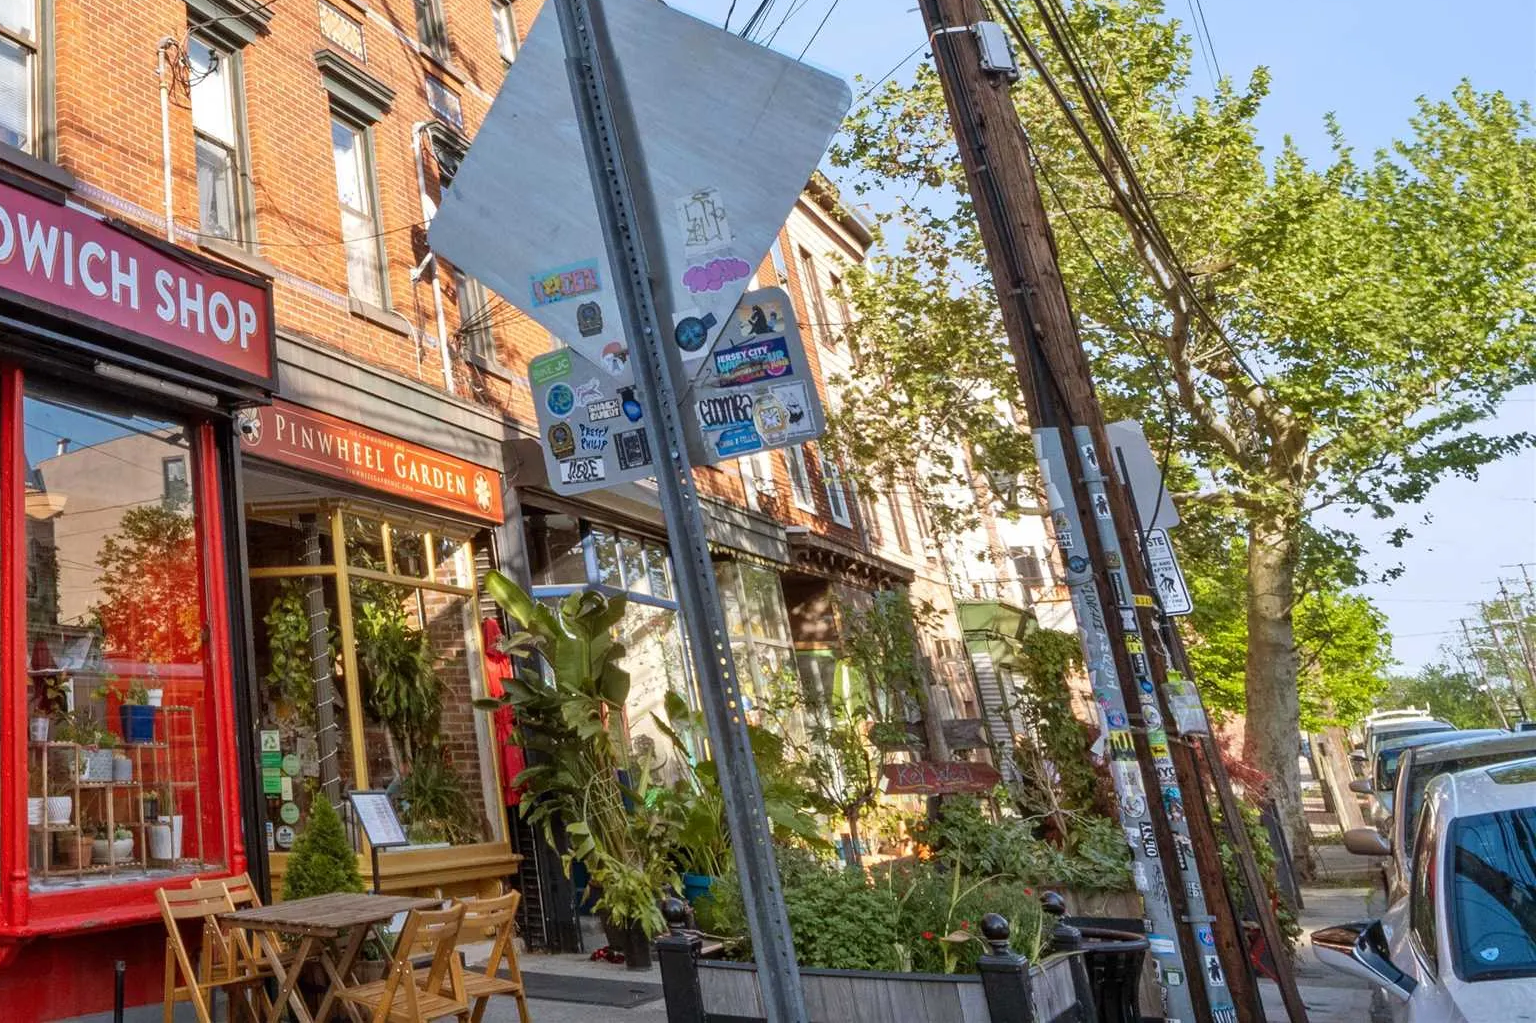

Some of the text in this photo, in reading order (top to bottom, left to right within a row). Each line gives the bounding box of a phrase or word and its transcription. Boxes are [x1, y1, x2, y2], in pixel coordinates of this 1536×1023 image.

[154, 268, 258, 349] SHOP
[716, 345, 768, 363] JERSEY CITY
[274, 413, 468, 496] PINWHEEL GARDEN
